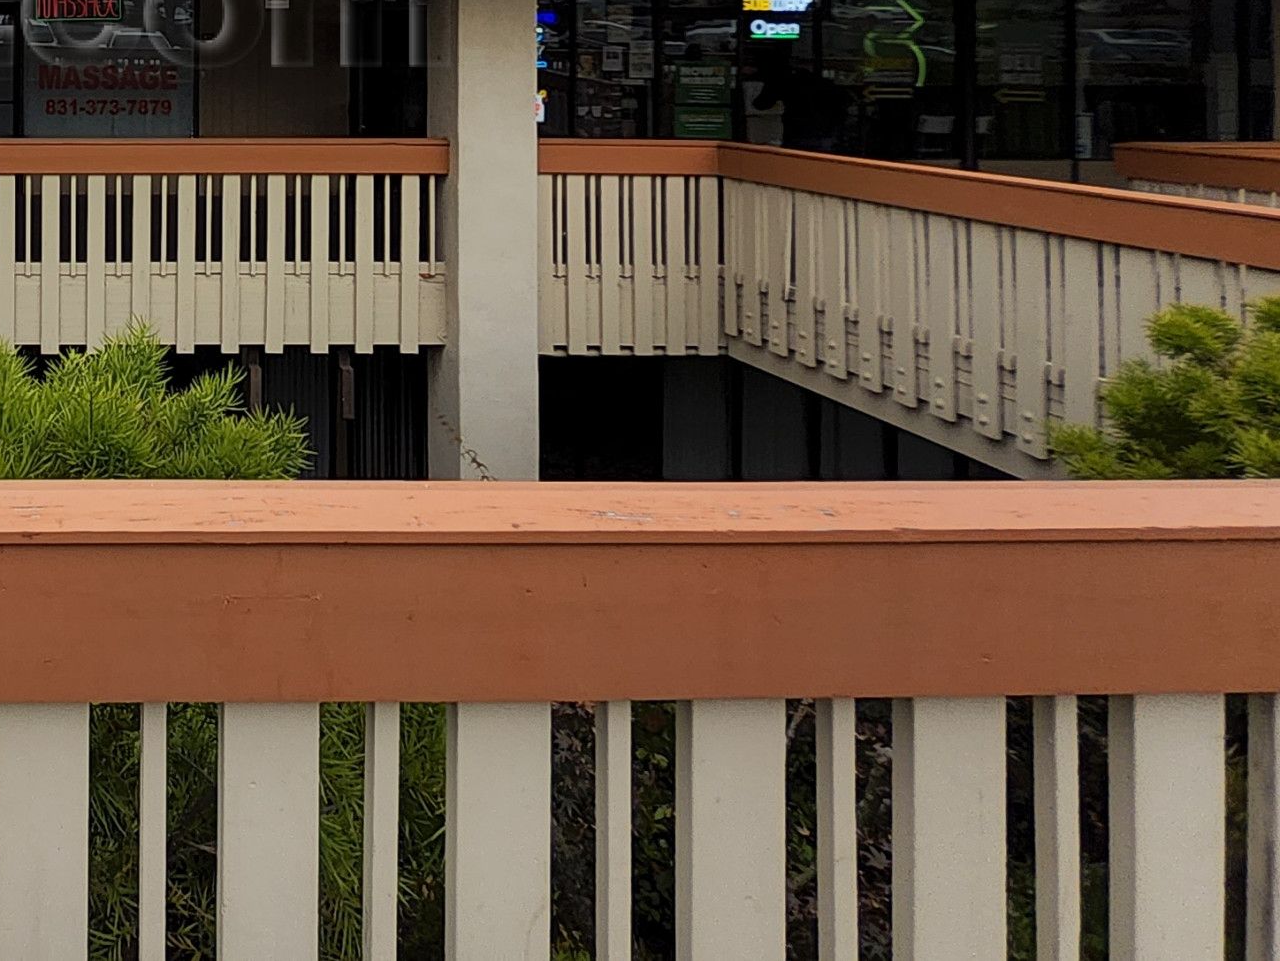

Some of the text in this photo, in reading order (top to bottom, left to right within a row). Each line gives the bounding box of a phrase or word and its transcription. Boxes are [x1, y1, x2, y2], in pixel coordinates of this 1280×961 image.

[750, 19, 800, 36] Open
[38, 64, 178, 90] MASSAGE
[45, 98, 172, 116] 831-373-7879
